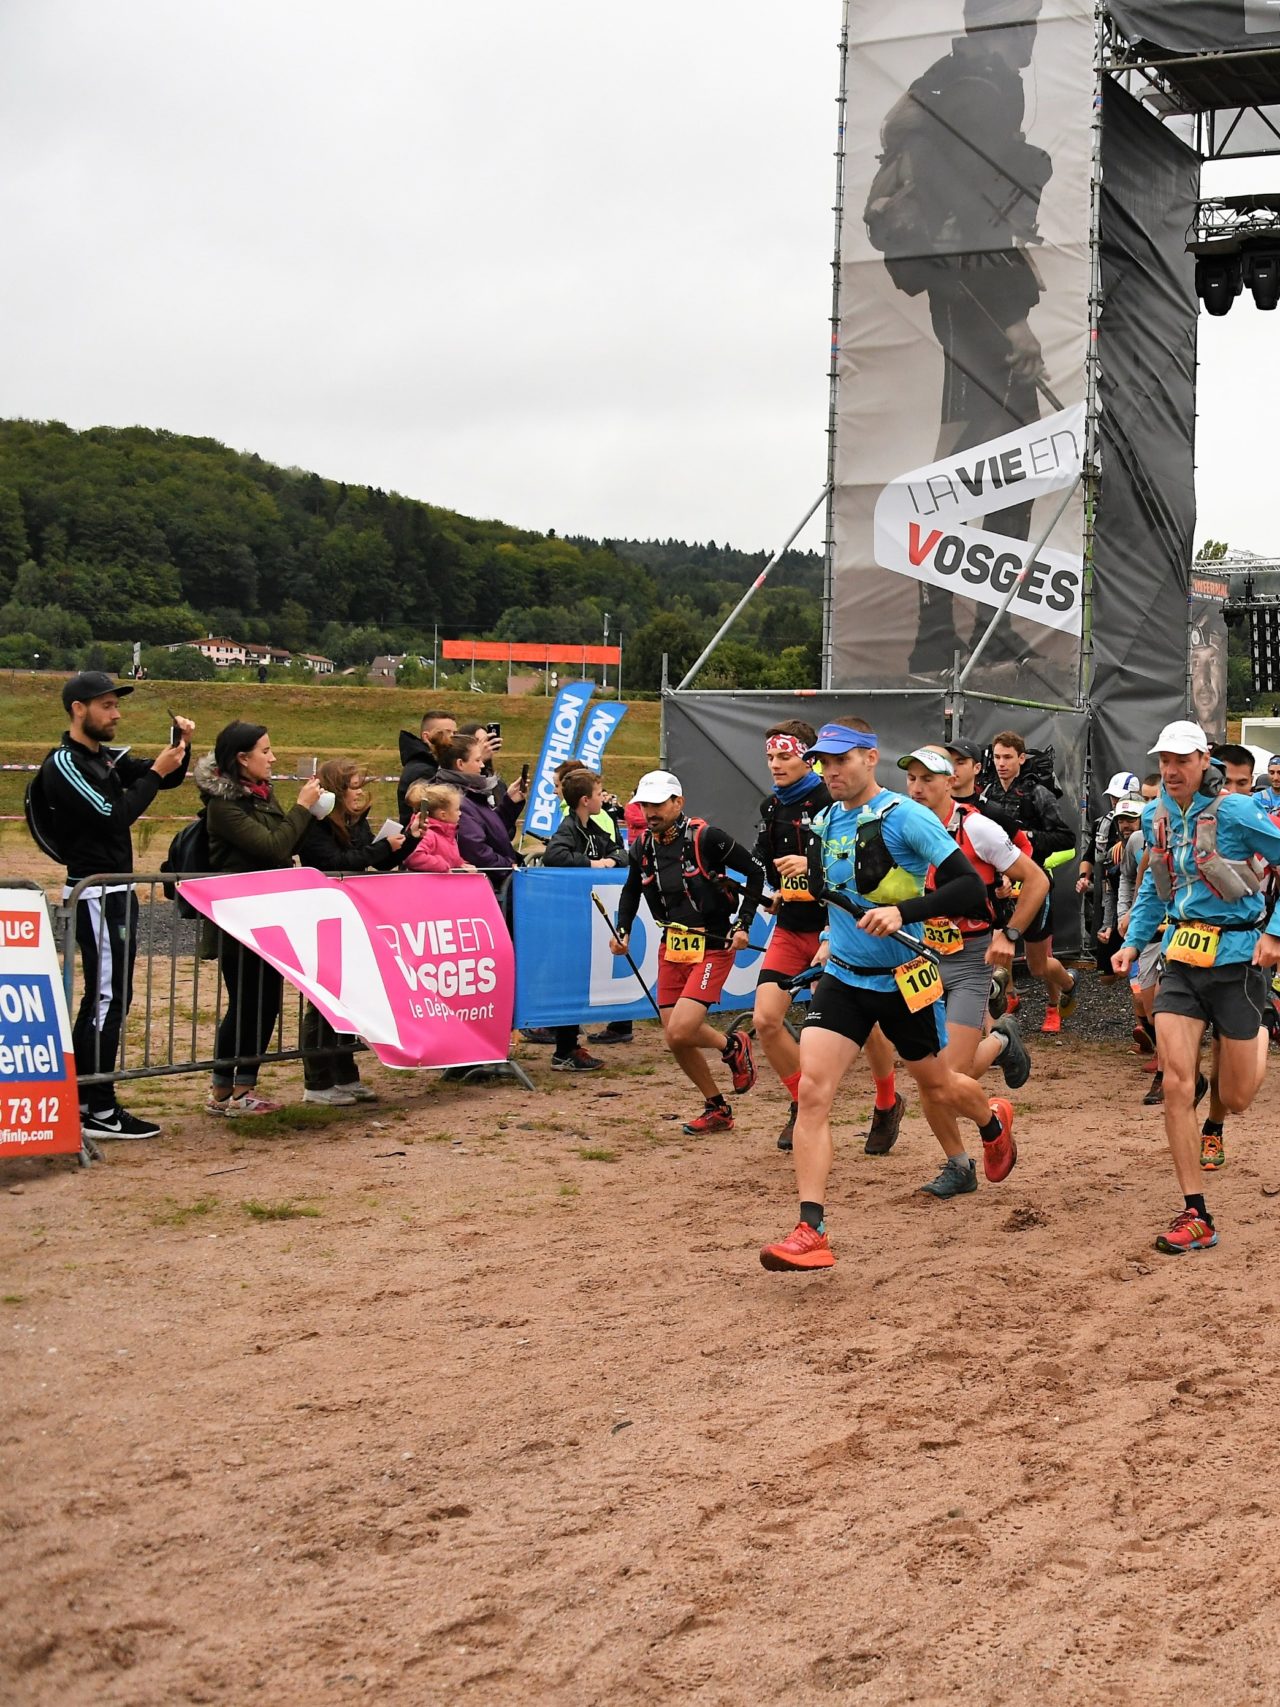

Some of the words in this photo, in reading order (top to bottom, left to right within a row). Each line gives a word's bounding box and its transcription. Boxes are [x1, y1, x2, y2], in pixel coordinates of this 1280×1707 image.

[908, 474, 959, 516] LA
[955, 448, 1027, 497] VIE
[1029, 430, 1080, 475] EN
[908, 522, 1079, 612] VOSGES
[530, 693, 583, 831] DECATHLON
[401, 919, 457, 957] VIE
[456, 918, 495, 953] EN
[394, 955, 497, 998] VSGES
[408, 998, 424, 1019] le
[0, 1033, 59, 1074] ériel
[8, 1098, 33, 1125] 73
[38, 1096, 59, 1123] 12
